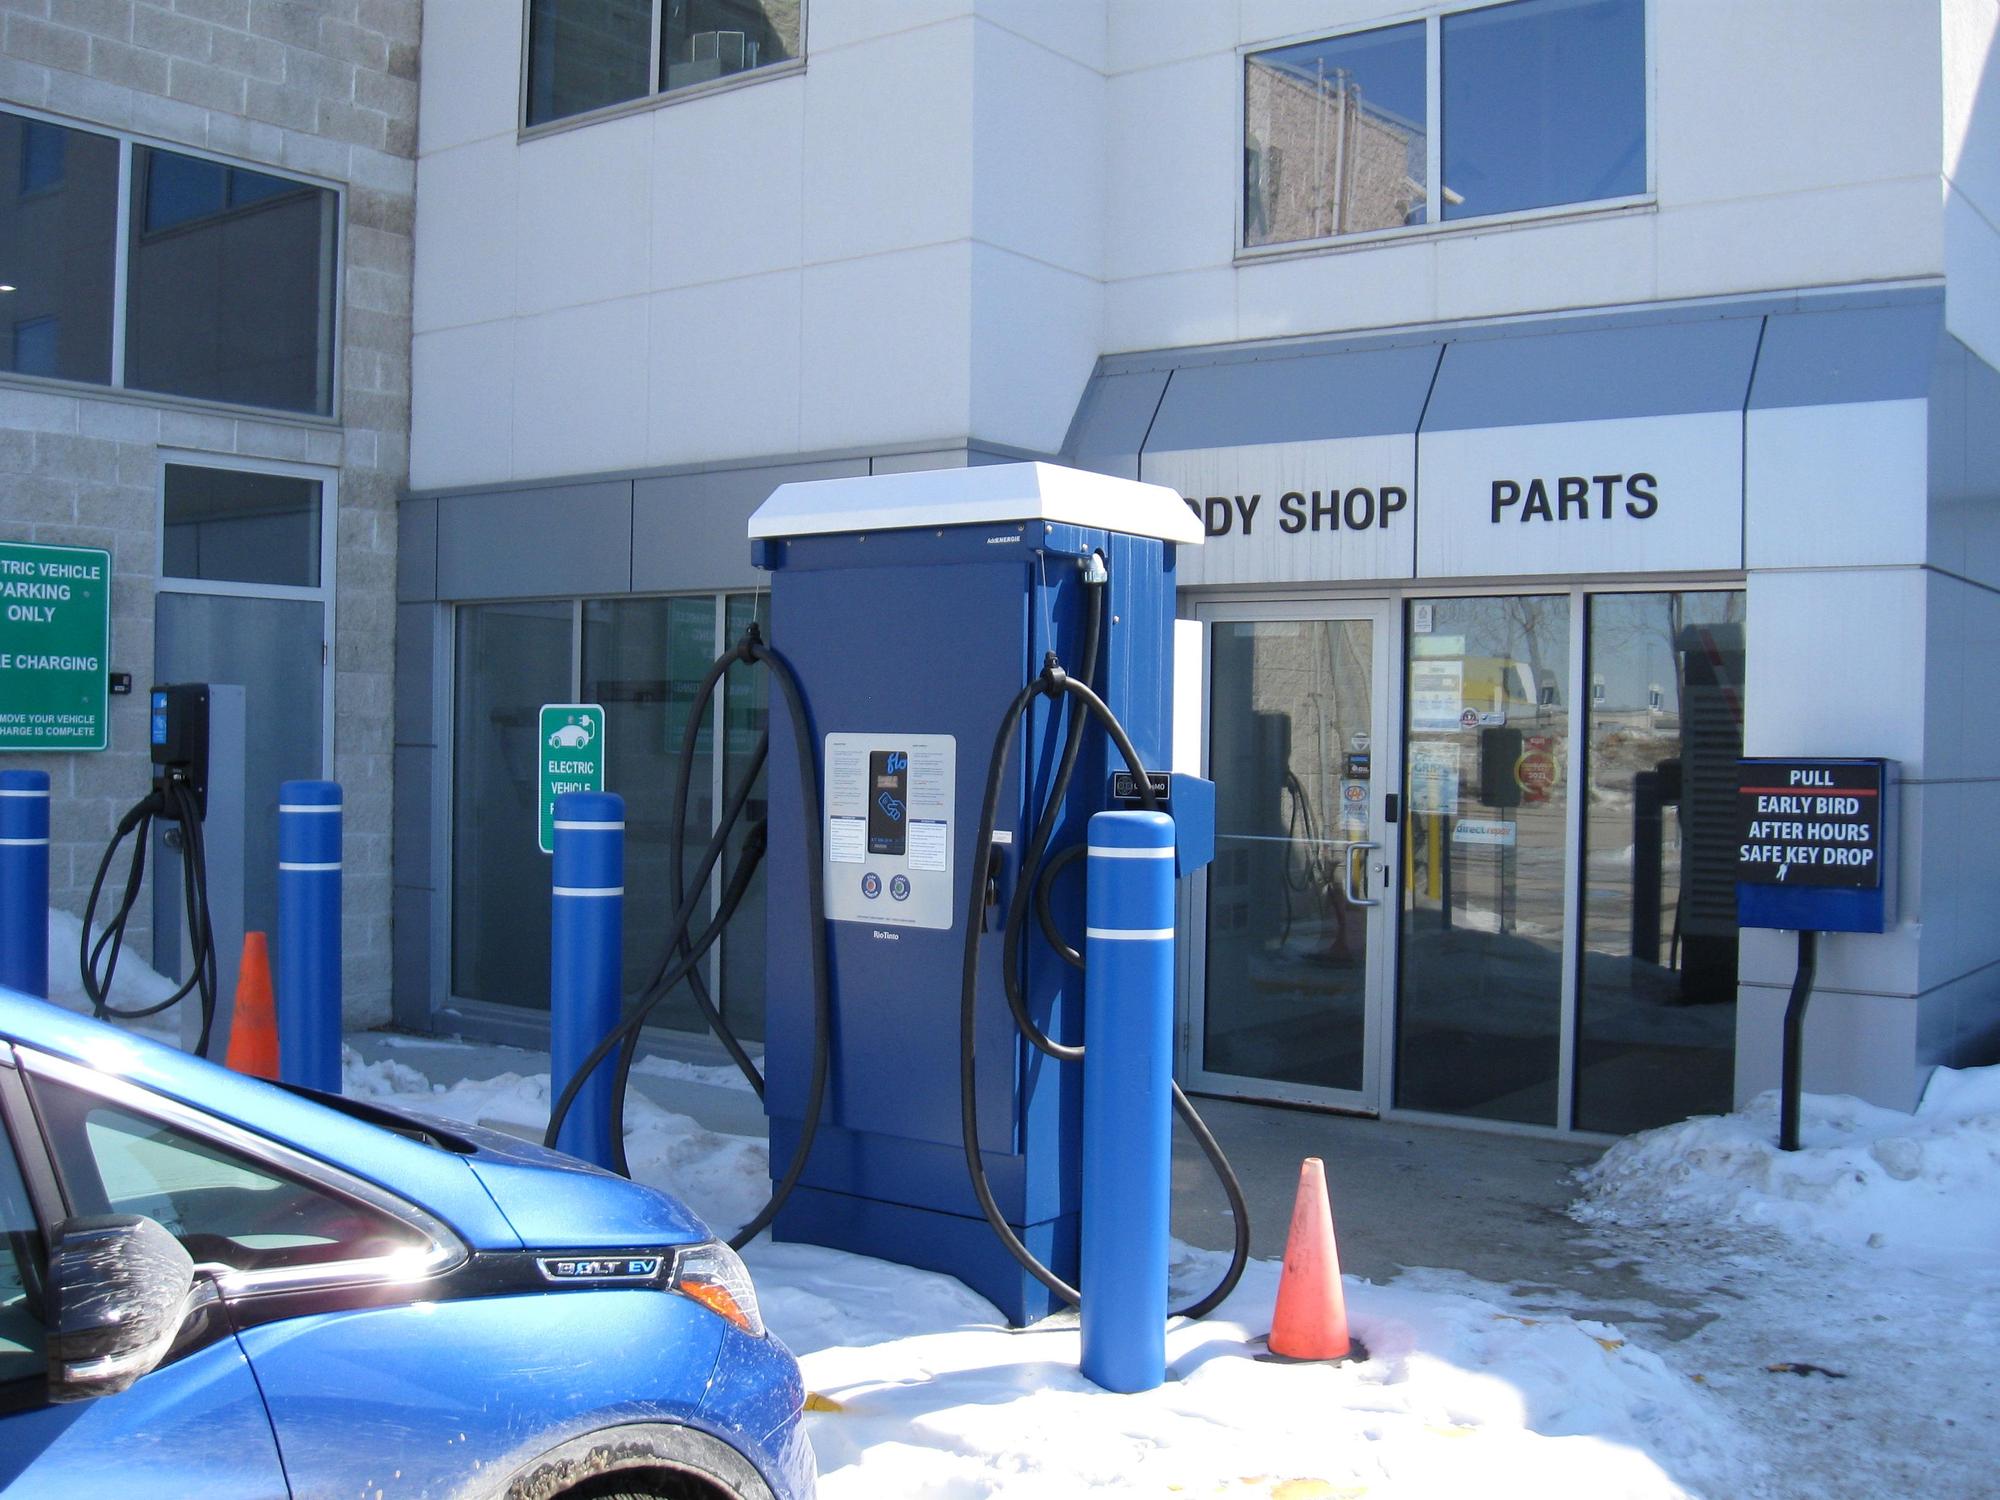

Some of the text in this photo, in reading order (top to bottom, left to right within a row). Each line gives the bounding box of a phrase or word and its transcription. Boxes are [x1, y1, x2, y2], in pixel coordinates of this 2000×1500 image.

[1491, 473, 1659, 523] PARTS
[1279, 486, 1407, 534] SHOP
[40, 563, 100, 580] VEHICLE
[8, 605, 56, 622] ONLY
[16, 655, 98, 671] CHARGING
[29, 715, 55, 724] YOUR
[57, 715, 95, 724] VEHICLE
[35, 727, 43, 736] IS
[46, 727, 95, 736] COMPLETE
[549, 760, 594, 774] ELECTRIC
[1790, 770, 1834, 786] PULL
[551, 782, 591, 794] VEHICLE
[1758, 796, 1859, 814] EARLY BIRD
[1456, 824, 1485, 834] direct
[1749, 821, 1869, 841] AFTER HOURS
[1740, 845, 1873, 865] SAFE KEY DROP
[628, 1261, 654, 1272] EV
